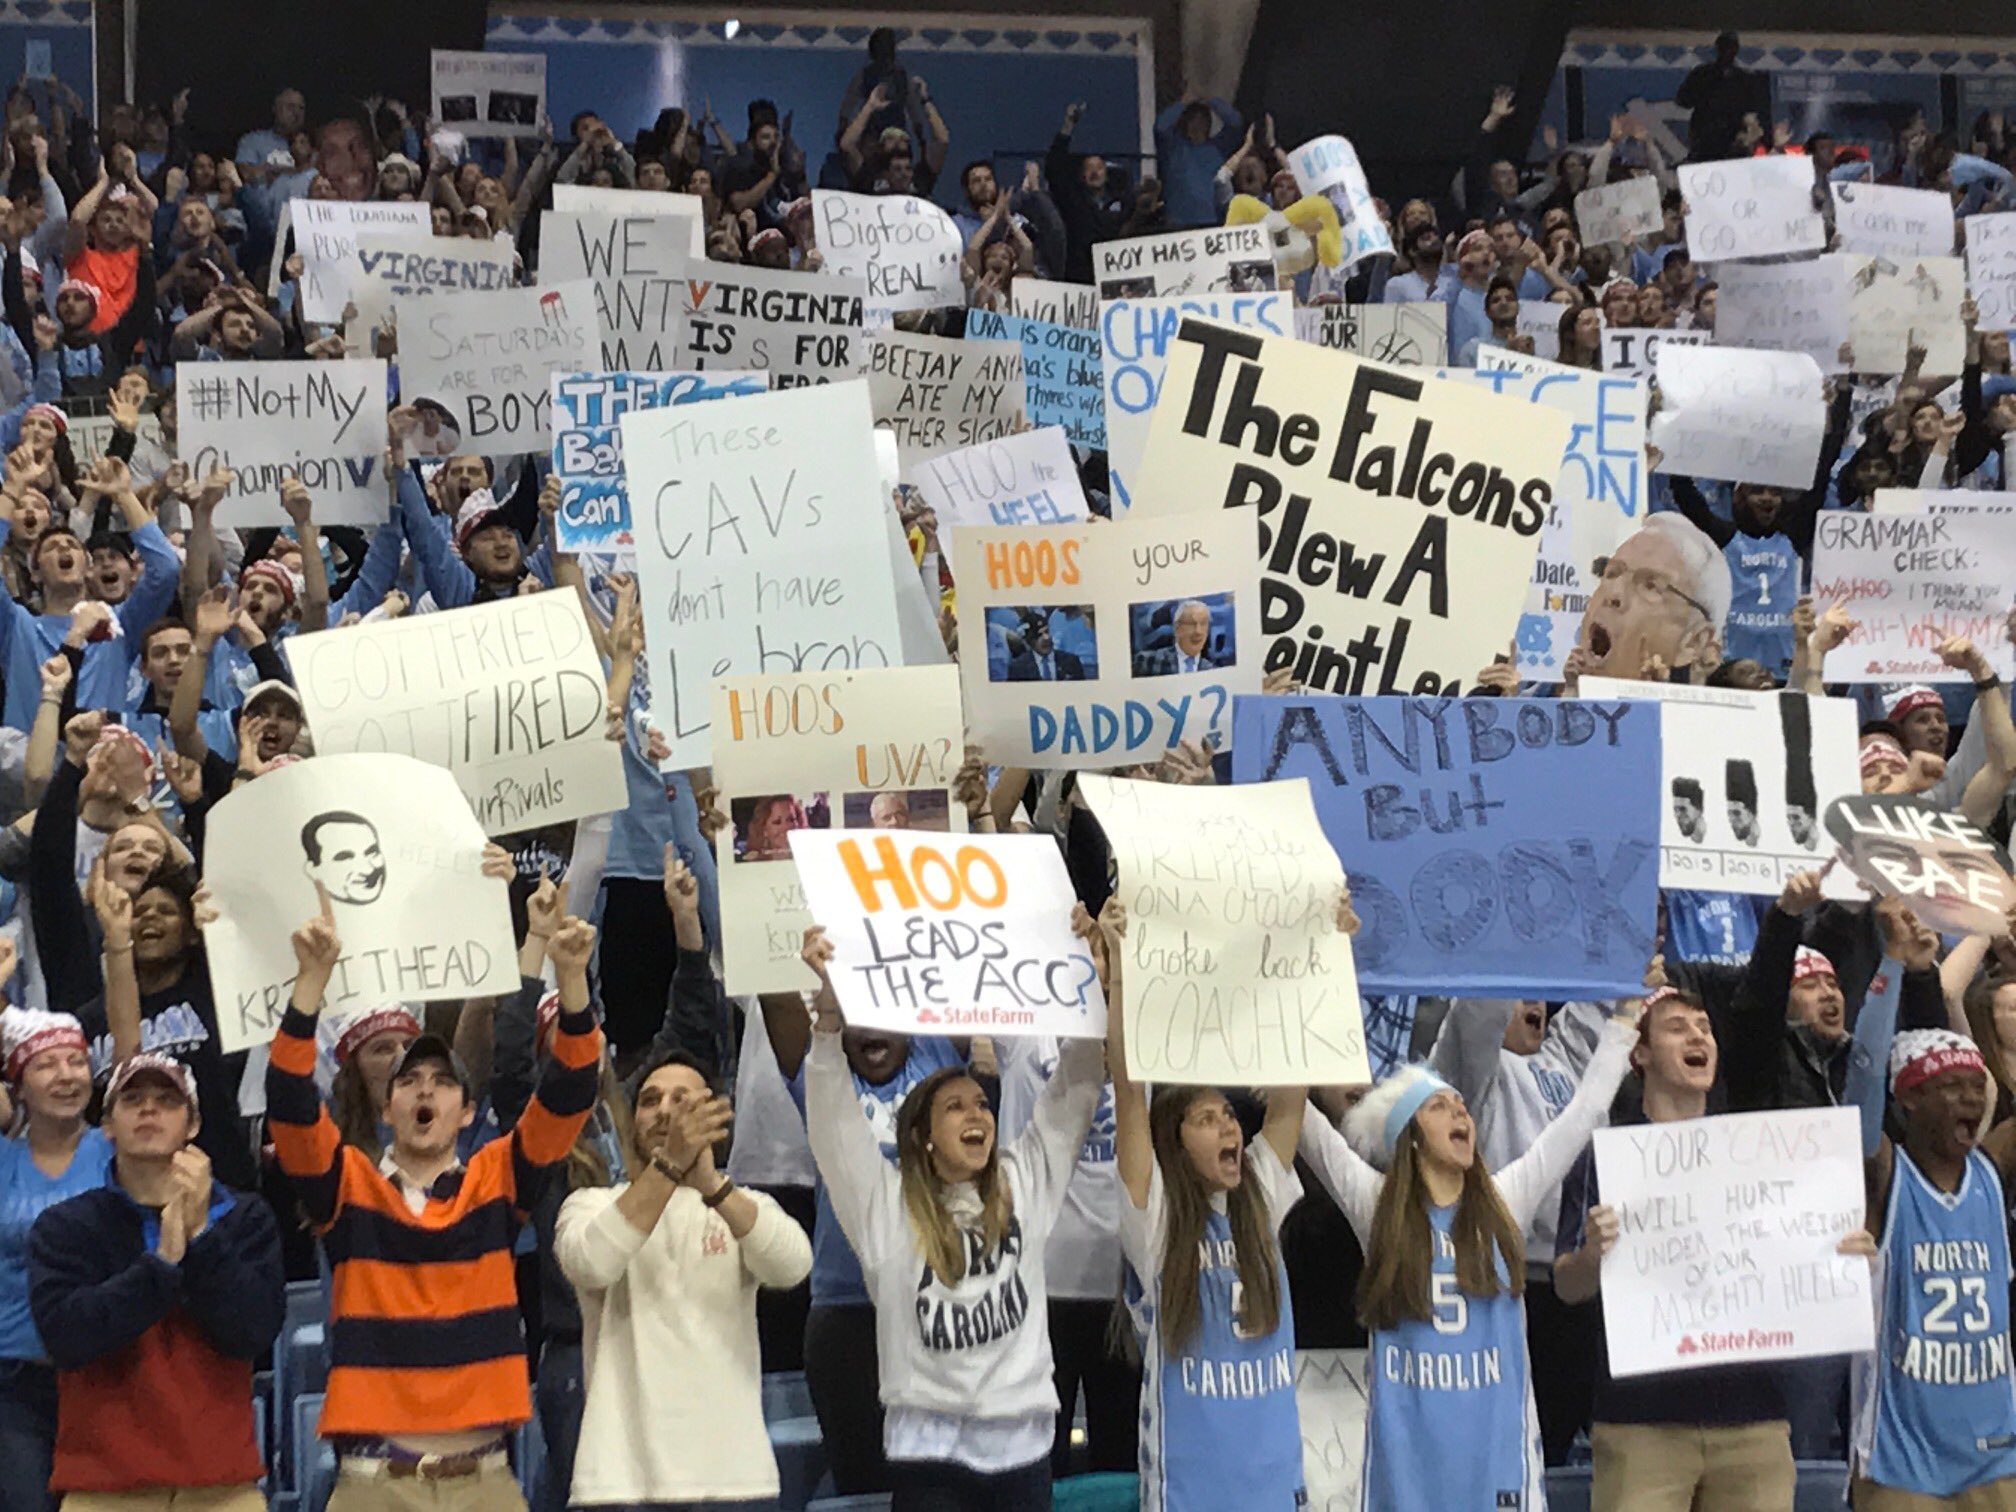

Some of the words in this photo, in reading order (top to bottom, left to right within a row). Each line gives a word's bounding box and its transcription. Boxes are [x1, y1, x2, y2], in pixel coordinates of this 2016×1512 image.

[306, 203, 335, 224] THE
[823, 196, 948, 260] Bigfoot
[358, 248, 515, 291] VIRGINIA
[576, 217, 659, 279] WE
[1104, 245, 1143, 273] ROY
[1152, 238, 1198, 264] HAS
[1203, 228, 1264, 257] BETTER
[688, 278, 864, 328] VIRGINIA
[866, 260, 937, 298] REAL
[594, 279, 686, 334] ANT
[688, 319, 736, 355] IS
[795, 334, 850, 368] FOR
[968, 311, 1009, 340] UVA
[1020, 321, 1040, 346] is
[1045, 327, 1103, 361] orang
[1319, 322, 1358, 349] OUR
[1610, 334, 1635, 369] I
[437, 369, 479, 392] ARE
[491, 363, 528, 386] FOR
[559, 376, 658, 429] THE
[896, 383, 949, 413] ATE
[962, 384, 1006, 414] MY
[660, 419, 783, 464] These
[1177, 316, 1320, 466] The
[1328, 364, 1553, 537] Falcons
[930, 442, 1017, 509] HOO
[655, 468, 824, 561] CAVs
[987, 488, 1078, 526] HEEL
[1818, 514, 1952, 551] GRAMMAR
[1223, 461, 1387, 599] Blew
[1383, 513, 1449, 619] A
[1893, 547, 1979, 573] CHECK:
[755, 571, 845, 614] have
[1756, 572, 1773, 605] 1
[1922, 582, 1968, 598] THINK
[1933, 598, 1983, 612] MEAN
[308, 600, 584, 710] GOTTFRIED
[1027, 684, 1229, 755] DADDY?
[1261, 695, 1632, 787] ANYBODY
[855, 737, 952, 790] UVA?
[1837, 801, 1997, 851] LUKE
[836, 835, 1008, 913] HOO
[1868, 854, 2005, 913] BAE
[1134, 884, 1180, 918] ON
[1186, 890, 1210, 916] A
[863, 915, 1009, 962] LEADS
[1133, 921, 1219, 977] broke
[1254, 933, 1332, 980] back
[852, 963, 949, 1008] THE
[973, 953, 1097, 1015] ACC?
[1630, 1126, 1712, 1179] YOUR
[1620, 1192, 1699, 1234] WILL
[1724, 1170, 1795, 1215] HURT
[1632, 1231, 1710, 1277] UNDER
[1726, 1218, 1770, 1243] THE
[1781, 1207, 1863, 1238] WEIGHT
[1913, 1241, 1991, 1274] NORTH
[915, 1270, 1029, 1351] CAROLINA
[1431, 1272, 1468, 1335] 5
[1651, 1271, 1768, 1341] MIGHTY
[1780, 1259, 1861, 1311] HEELS
[1922, 1275, 1992, 1333] 23
[1181, 1347, 1292, 1400] CAROLIN
[1384, 1344, 1502, 1392] CAROLIN
[1896, 1327, 2010, 1385] AROLIN
